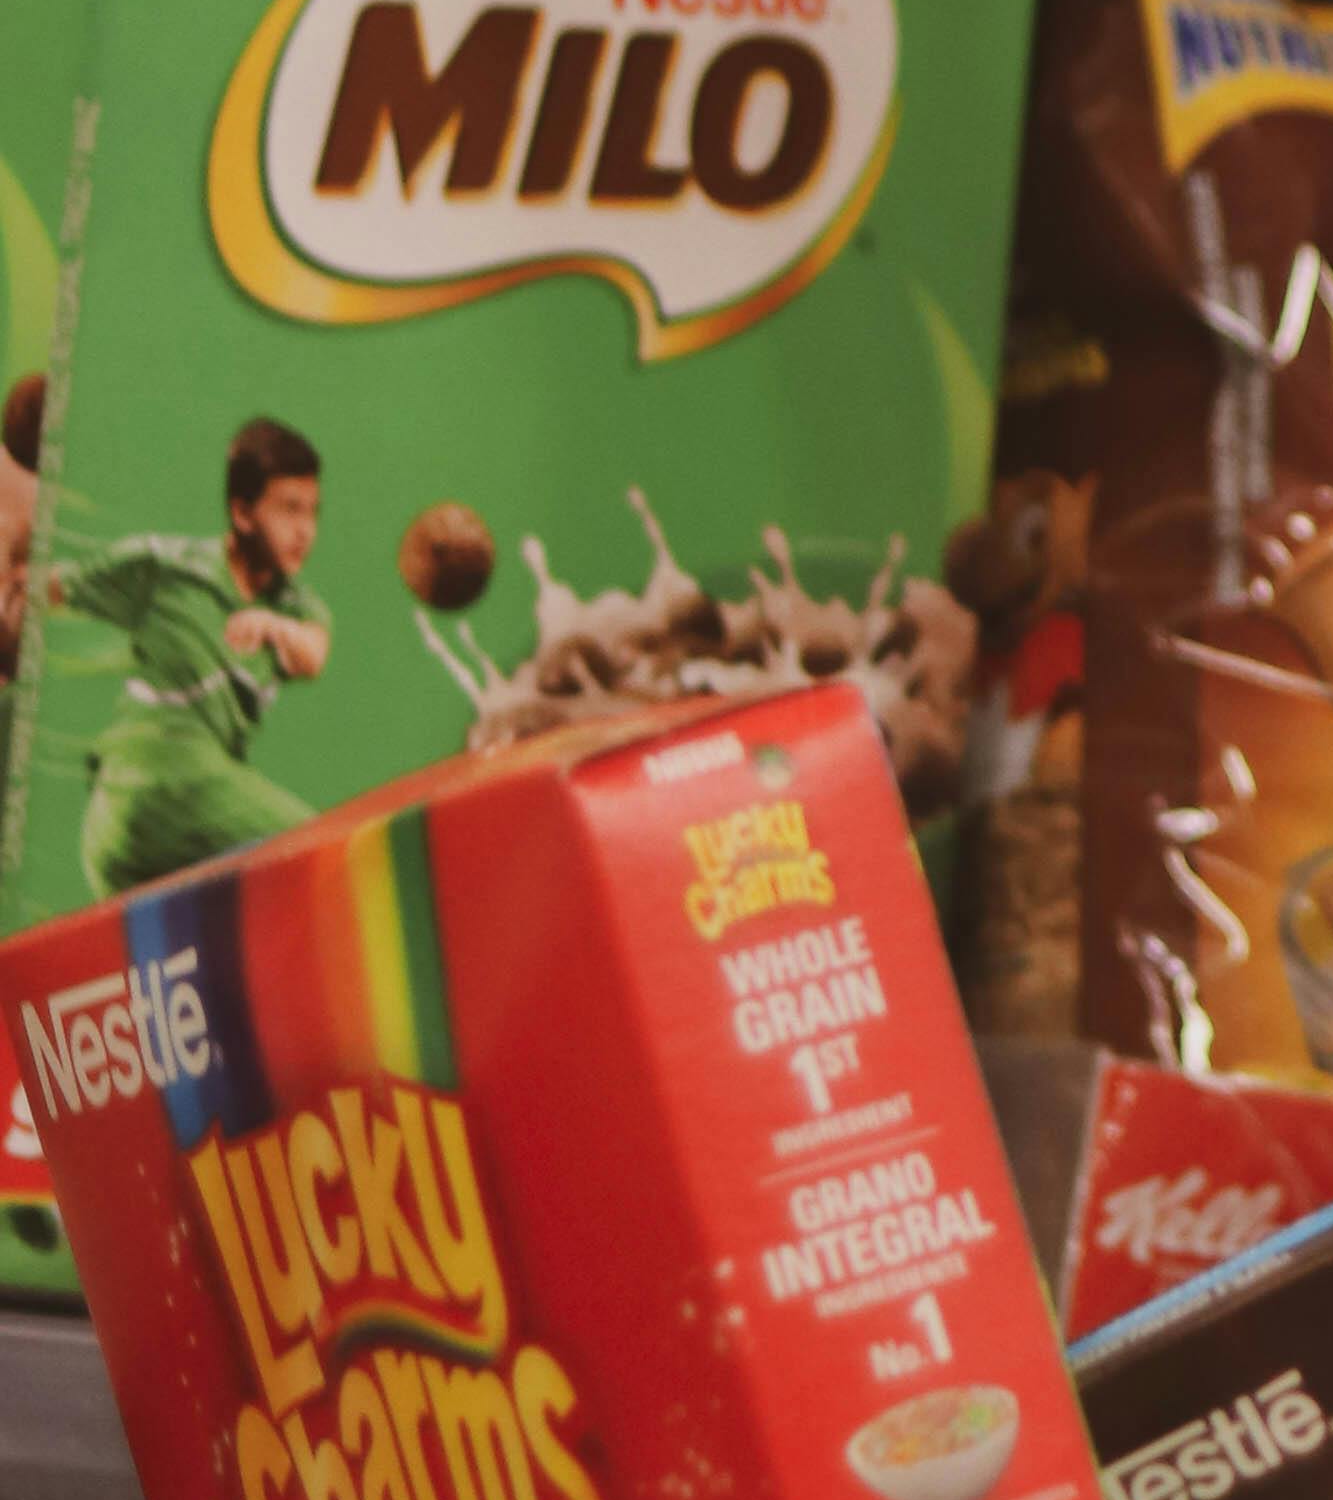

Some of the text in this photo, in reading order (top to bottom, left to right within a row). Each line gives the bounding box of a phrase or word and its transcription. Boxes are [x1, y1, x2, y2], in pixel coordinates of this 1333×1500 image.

[313, 0, 835, 216] MILO
[684, 800, 809, 880] Lucky
[684, 848, 836, 942] Charms
[720, 916, 874, 1000] WHOLE
[21, 946, 212, 1120] Nestlé
[733, 965, 888, 1056] GRAIN
[789, 1150, 935, 1231] GRANO
[190, 1087, 508, 1412] Lucky
[762, 1188, 996, 1300] INTEGRAL
